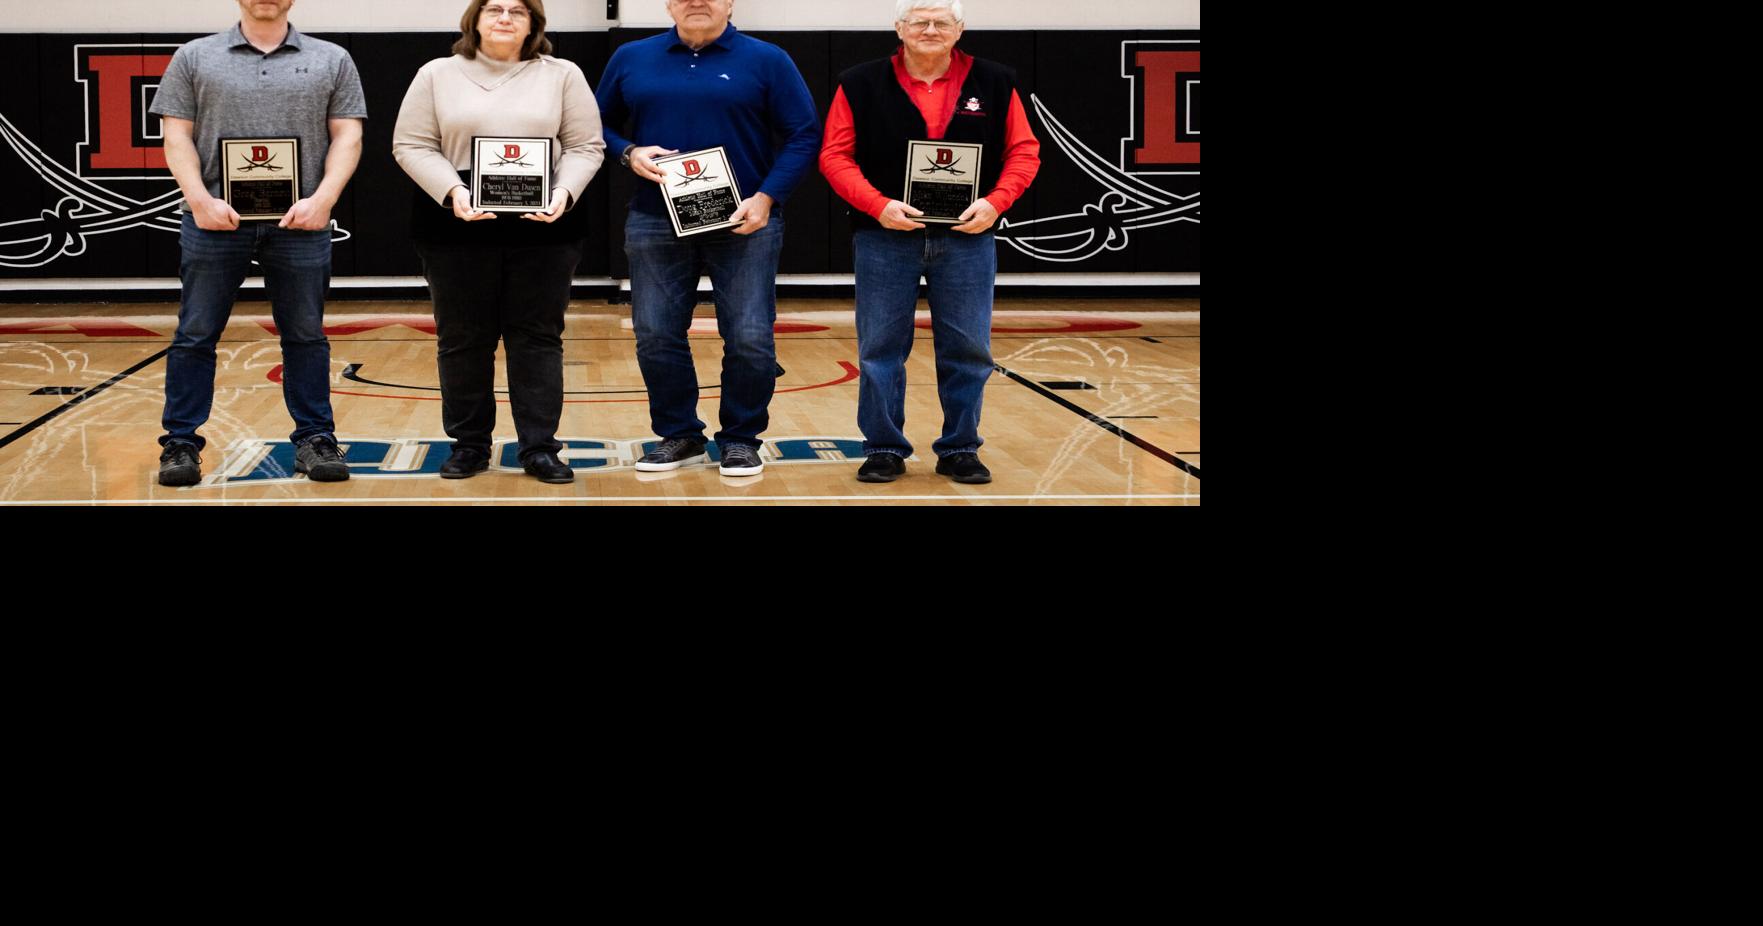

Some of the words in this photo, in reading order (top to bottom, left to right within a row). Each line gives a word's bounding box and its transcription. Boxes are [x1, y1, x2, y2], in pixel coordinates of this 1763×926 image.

[251, 145, 268, 161] D
[503, 145, 520, 158] D
[936, 148, 953, 164] D
[682, 159, 701, 176] D
[482, 182, 504, 191] Cheryl
[507, 183, 519, 191] Van
